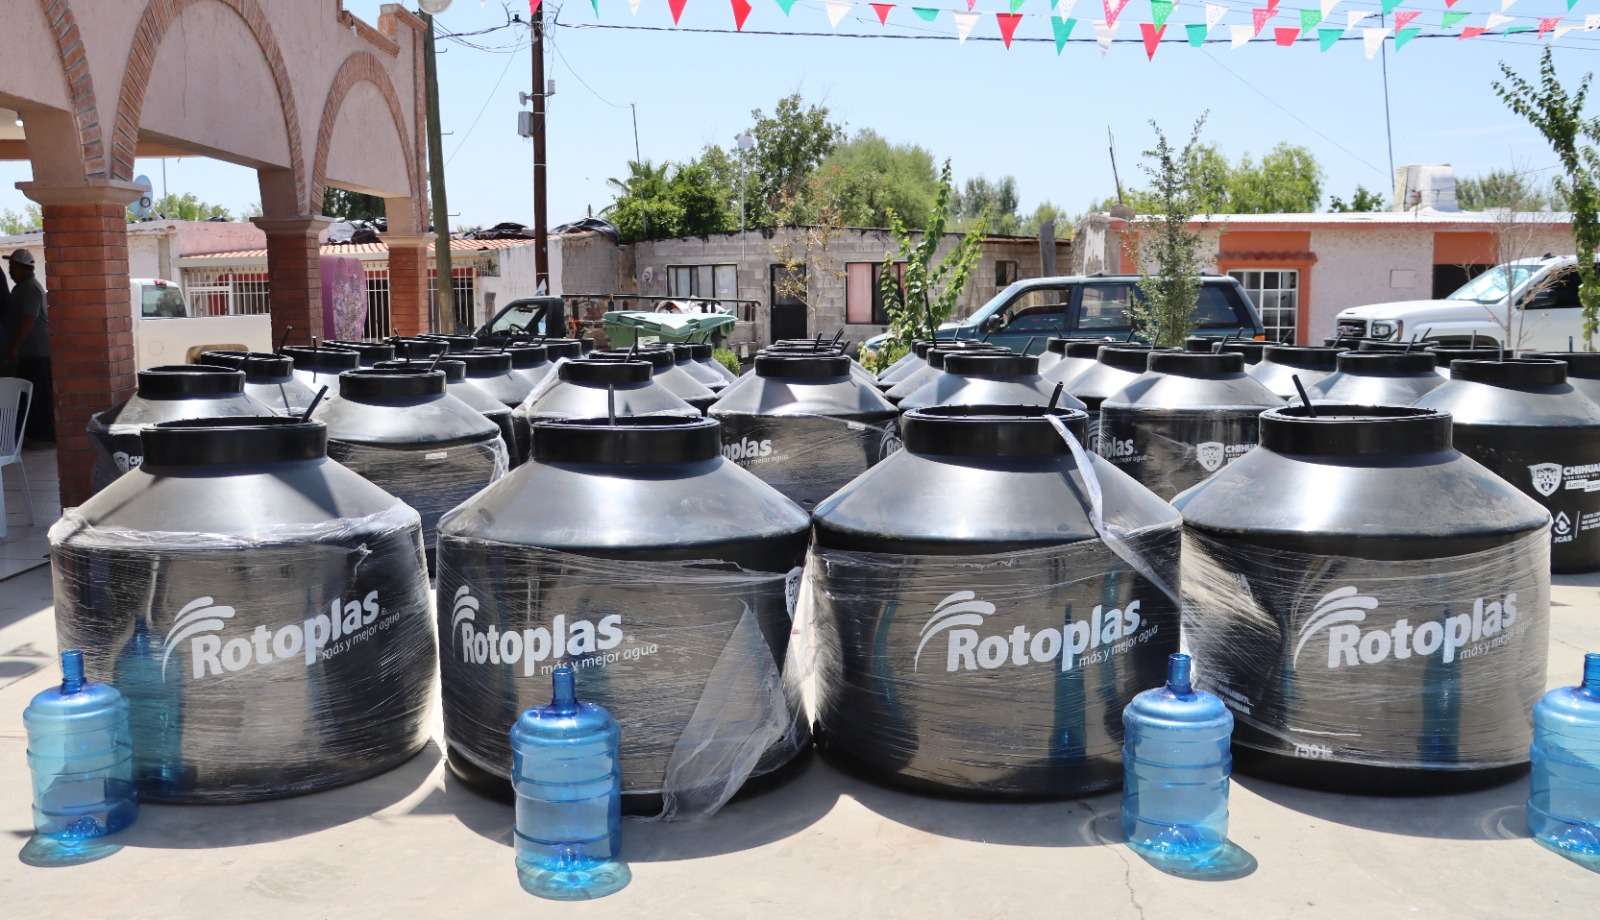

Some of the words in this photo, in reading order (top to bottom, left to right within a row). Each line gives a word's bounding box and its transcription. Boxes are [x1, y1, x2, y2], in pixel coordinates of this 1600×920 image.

[720, 437, 772, 460] oplas
[191, 589, 380, 680] Rotoplas
[322, 643, 344, 659] más
[344, 637, 352, 653] y
[352, 625, 378, 645] mejor
[379, 611, 401, 633] agua
[461, 613, 624, 677] Rotoplas
[946, 599, 1141, 673] Rotoplas
[1078, 651, 1102, 668] más
[1103, 648, 1111, 664] y
[1111, 636, 1137, 655] mejor
[1138, 624, 1159, 643] agua
[1327, 592, 1518, 669] Rotoplas
[1459, 644, 1483, 661] más
[1482, 640, 1490, 656] y
[570, 661, 579, 674] y
[581, 652, 620, 671] mejor
[623, 642, 658, 661] agua
